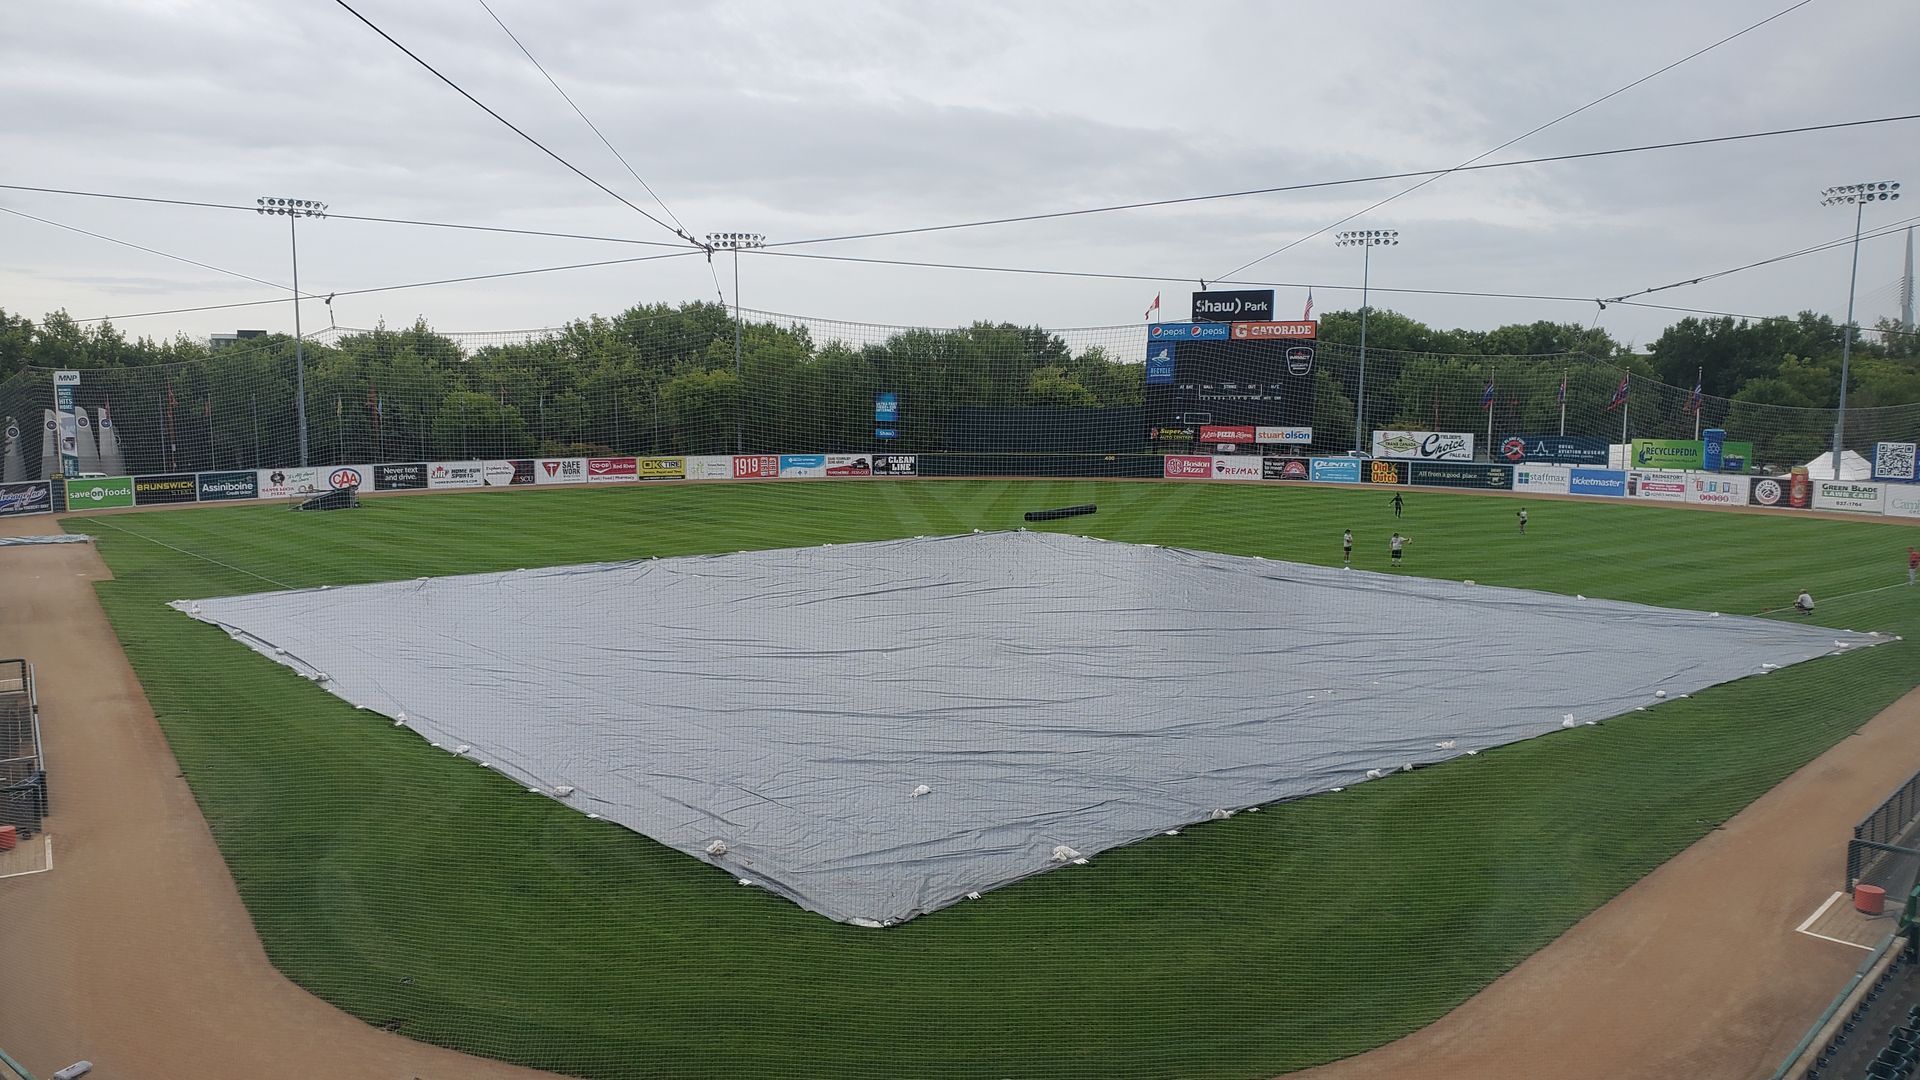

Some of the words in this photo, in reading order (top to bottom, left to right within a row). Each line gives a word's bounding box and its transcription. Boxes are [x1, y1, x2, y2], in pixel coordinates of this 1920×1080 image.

[1244, 300, 1268, 311] Park
[1163, 326, 1186, 337] pepsi
[1202, 325, 1226, 336] pepsi
[1251, 324, 1311, 336] GATORADE
[1258, 429, 1310, 440] stuartolson
[1421, 434, 1466, 458] Choice
[1646, 446, 1698, 457] RECYCLEPEDIA
[643, 461, 660, 469] OK
[735, 458, 758, 476] 1919
[1372, 461, 1389, 472] Old
[1225, 467, 1259, 476] RE/MAX
[1530, 472, 1566, 482] staffmax
[333, 471, 358, 487] CAA
[1372, 472, 1398, 484] Dutch
[1572, 476, 1622, 487] ticketmaster
[136, 481, 194, 491] BRUNSWICK
[202, 482, 254, 492] Assiniboine
